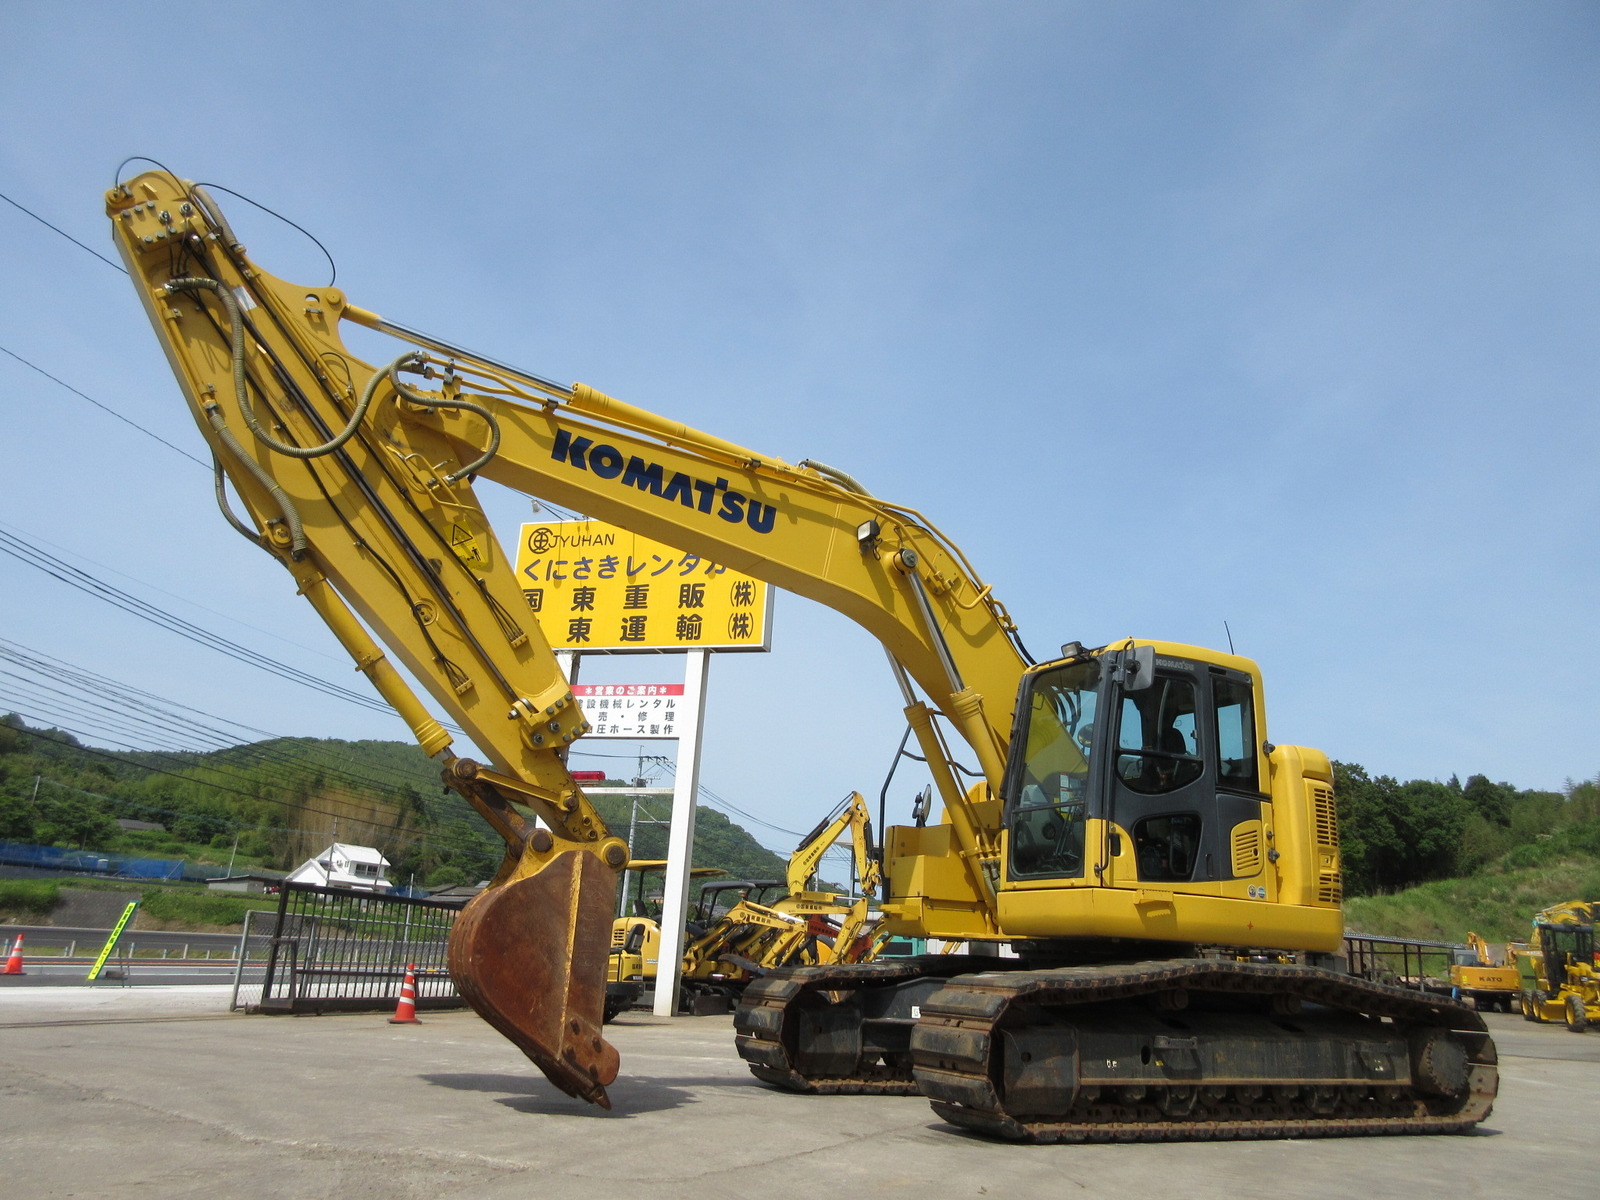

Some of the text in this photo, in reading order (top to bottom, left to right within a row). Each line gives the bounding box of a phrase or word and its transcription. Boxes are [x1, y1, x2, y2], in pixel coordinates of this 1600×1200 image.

[550, 427, 777, 534] KOMATSU
[536, 612, 754, 643] 東運輸(株)
[1155, 658, 1195, 671] KOMATSU
